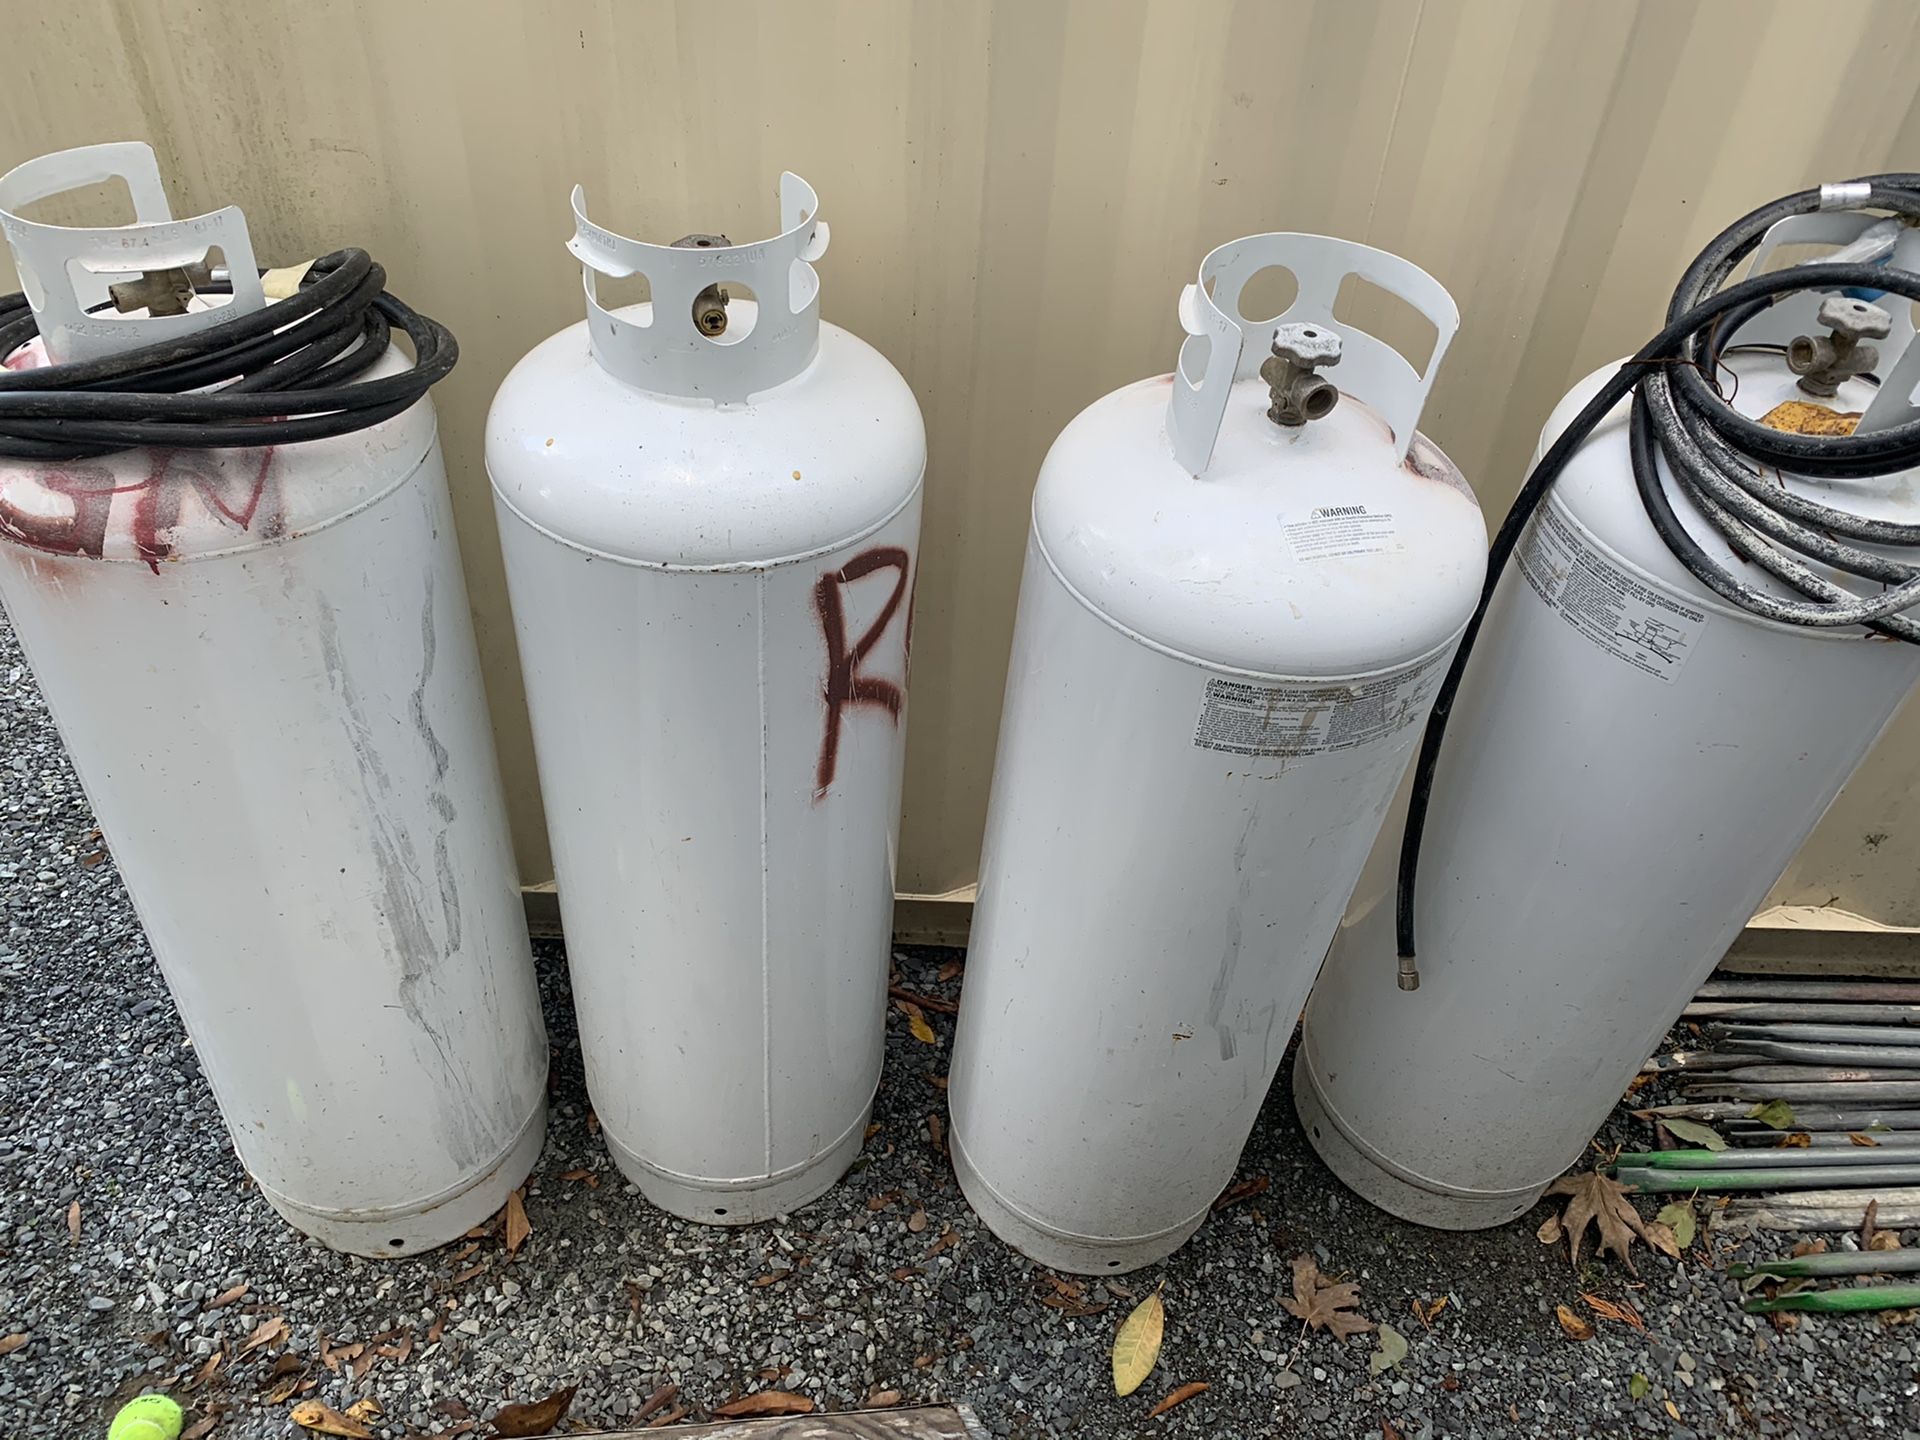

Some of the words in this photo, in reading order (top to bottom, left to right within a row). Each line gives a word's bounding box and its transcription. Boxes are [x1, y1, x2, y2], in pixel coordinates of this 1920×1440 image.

[1320, 505, 1367, 517] WARNING
[1611, 568, 1620, 576] MAY
[1619, 574, 1634, 585] CAUSE
[1636, 584, 1647, 593] FIRE
[1654, 594, 1680, 608] EXPLOSION
[1684, 607, 1704, 619] IGNITED
[1646, 594, 1656, 602] FOR
[1655, 599, 1678, 613] OUTDOOR
[813, 547, 910, 802] R
[1217, 680, 1252, 690] DANGER
